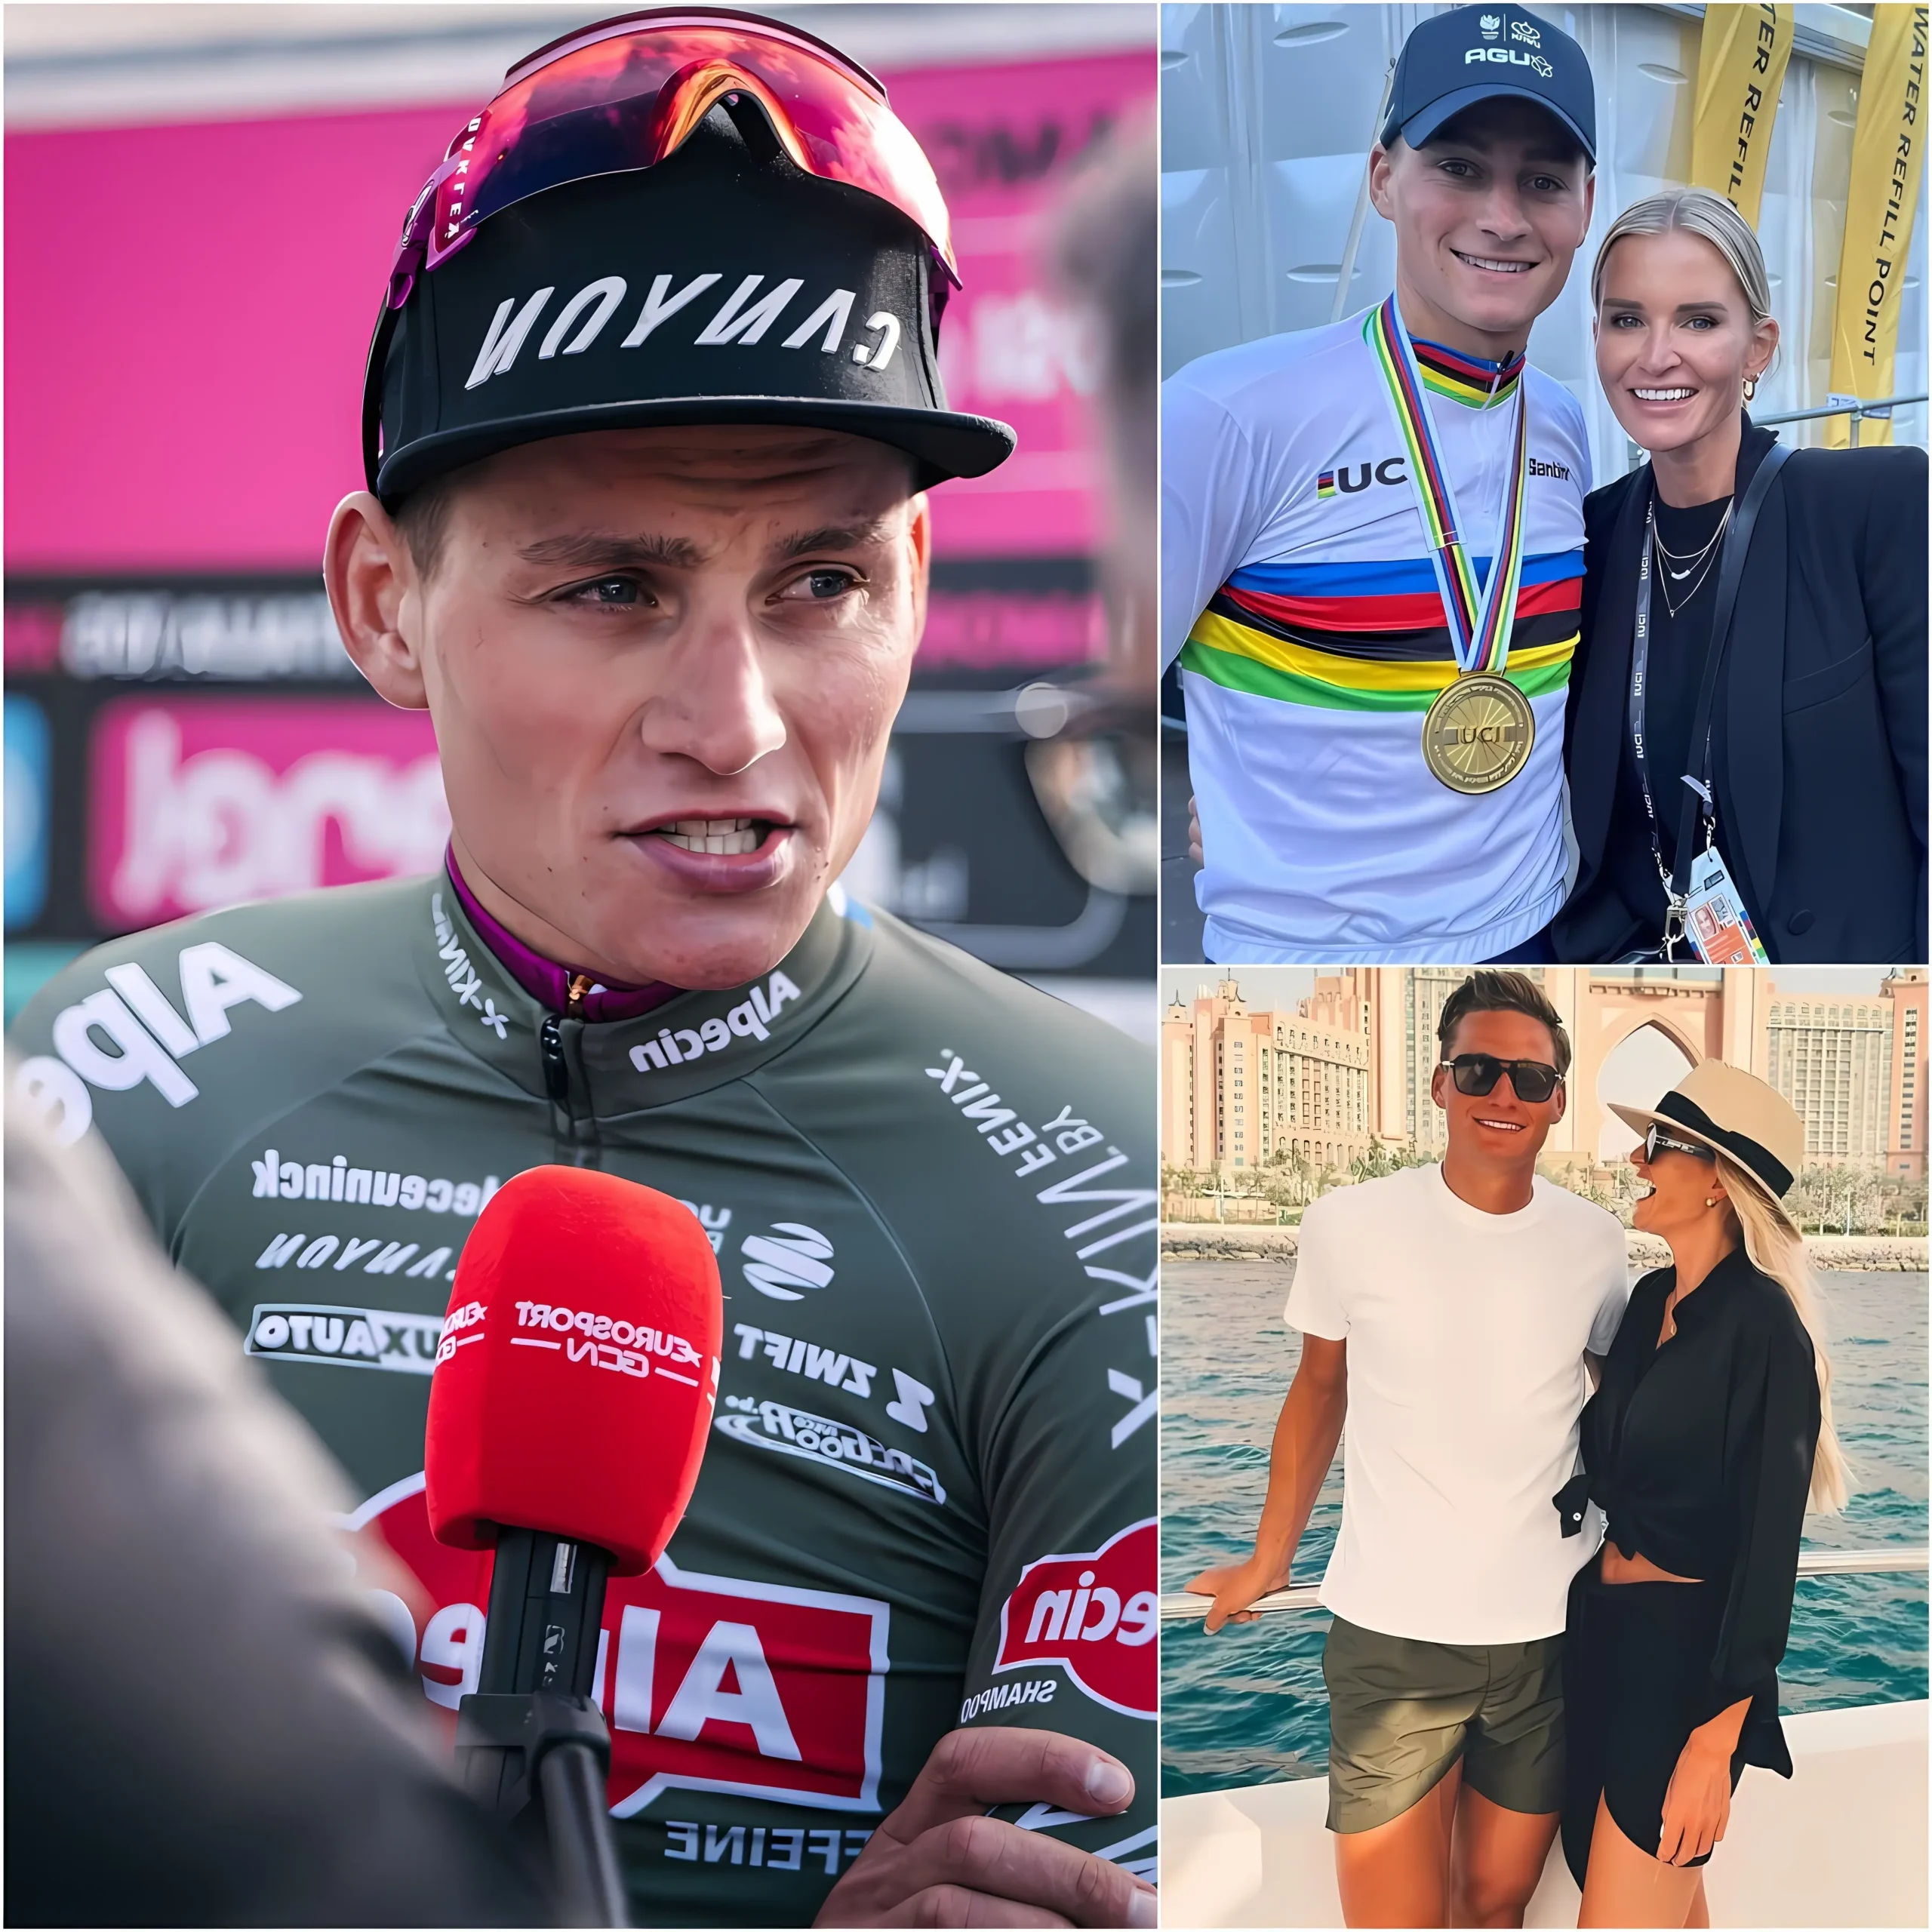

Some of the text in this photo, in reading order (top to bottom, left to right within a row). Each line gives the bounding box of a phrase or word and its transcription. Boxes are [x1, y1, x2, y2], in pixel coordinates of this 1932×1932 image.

[1465, 48, 1531, 66] AGU
[1863, 7, 1929, 366] WATER REFILL POINT
[1337, 457, 1409, 494] UC
